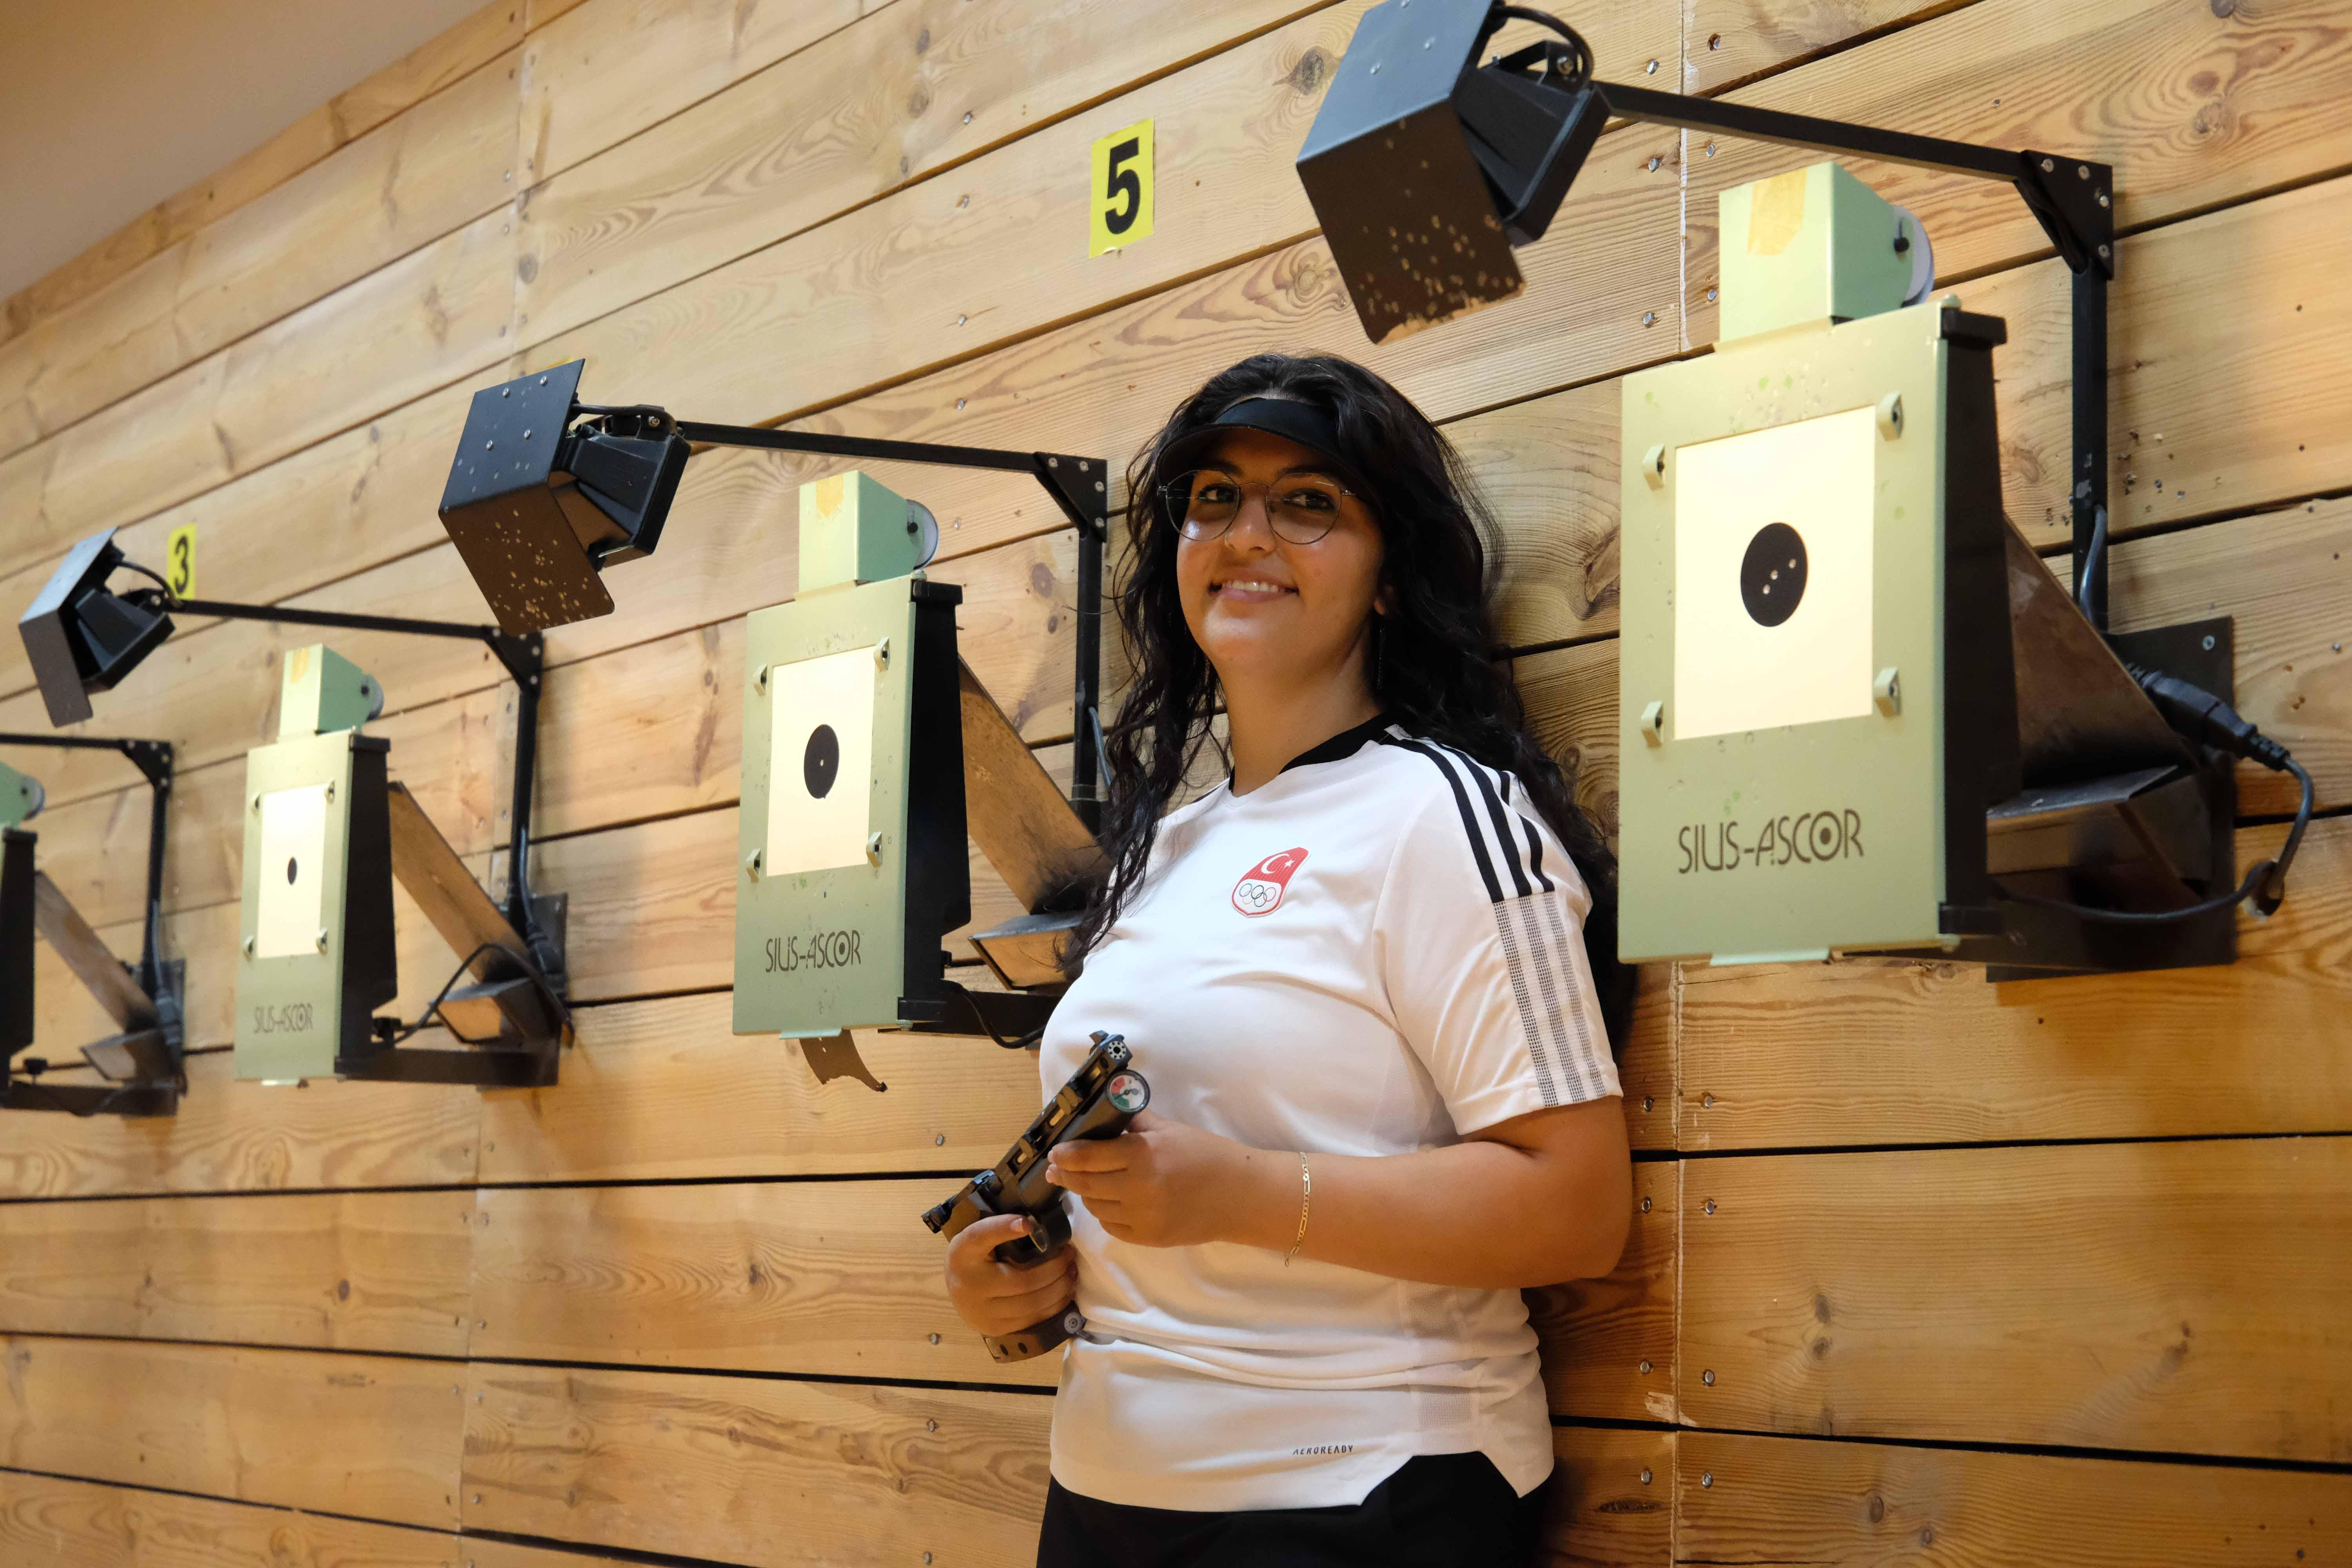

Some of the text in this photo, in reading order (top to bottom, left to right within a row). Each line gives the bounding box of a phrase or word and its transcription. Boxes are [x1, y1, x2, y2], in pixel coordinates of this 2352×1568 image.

[1105, 136, 1141, 234] 5
[175, 535, 189, 594] 3
[1678, 809, 1864, 874] SIUS-ASCOR
[765, 929, 861, 973] SIUS-ASCOR
[1293, 1445, 1353, 1455] AEROREADY
